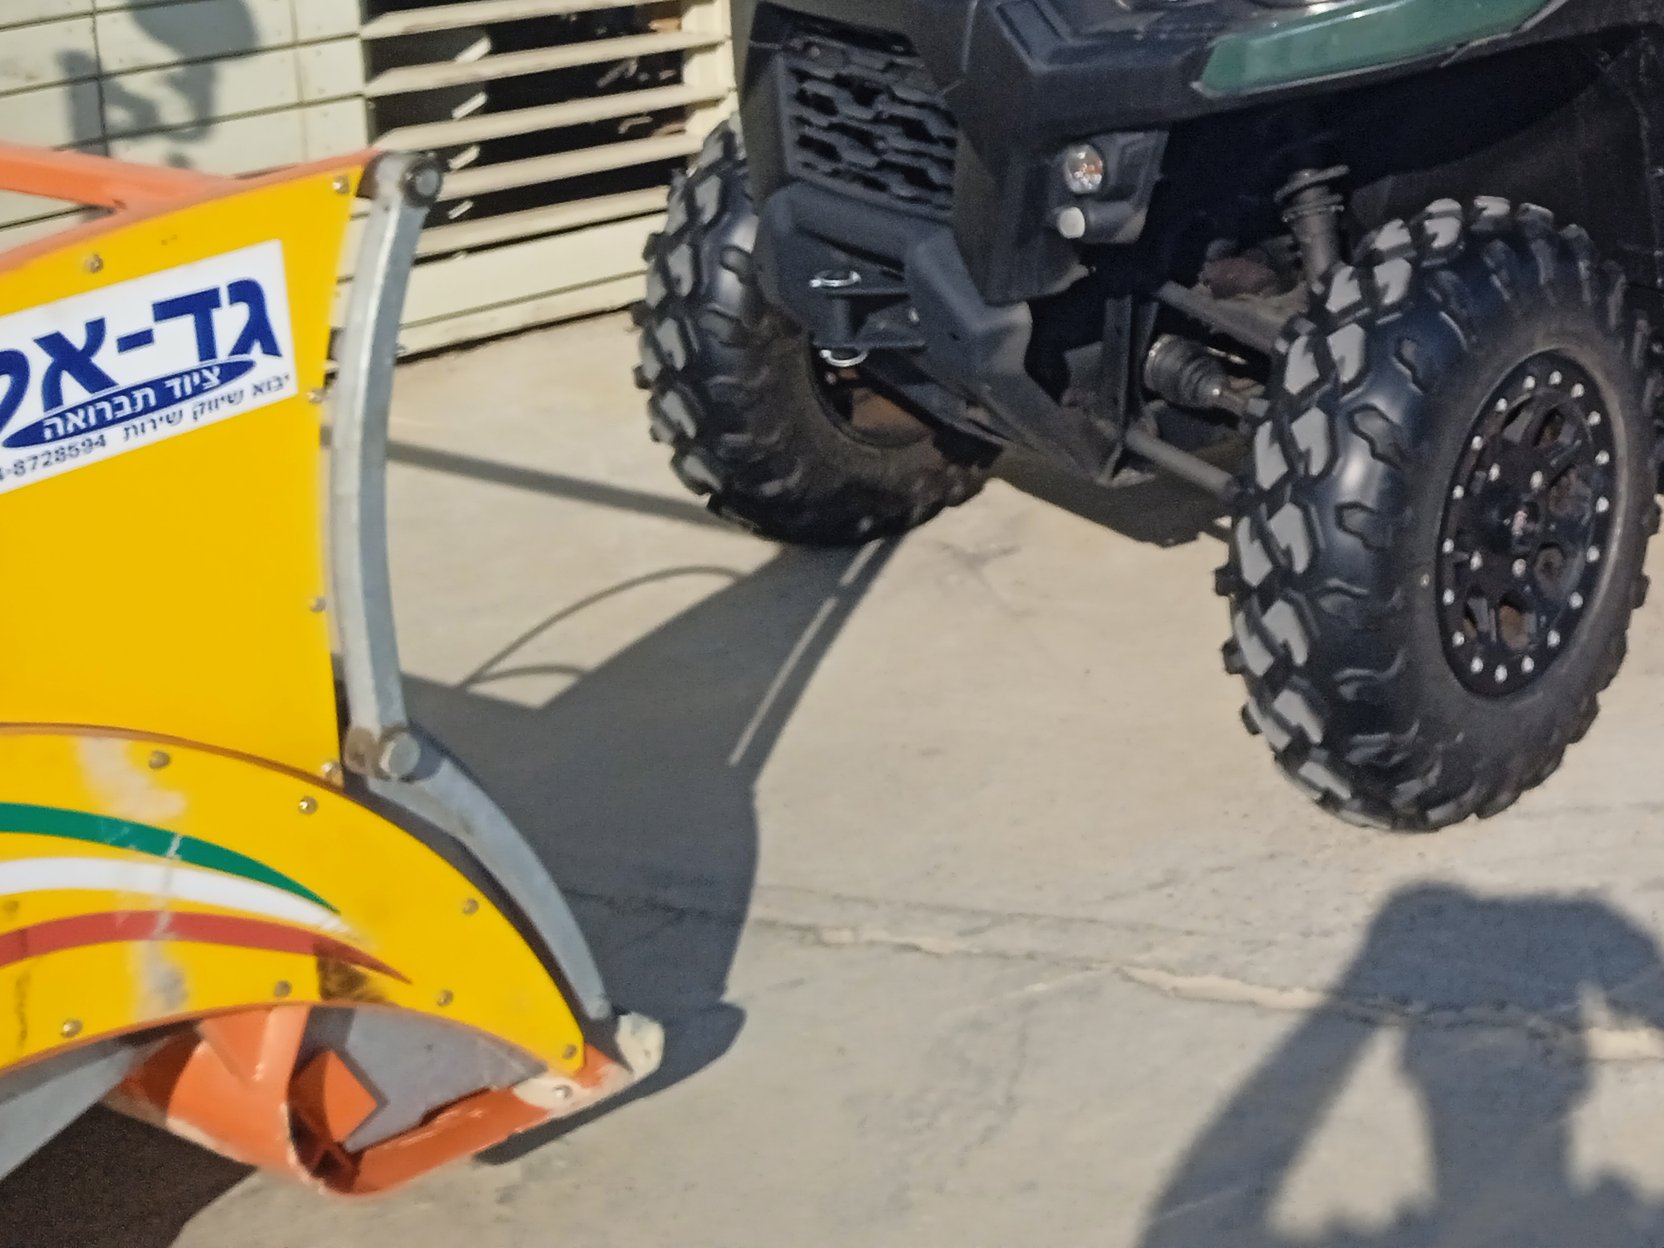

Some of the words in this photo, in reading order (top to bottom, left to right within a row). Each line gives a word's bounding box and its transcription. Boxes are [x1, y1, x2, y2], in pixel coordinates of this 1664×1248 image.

[164, 365, 222, 400] ציוד
[252, 373, 290, 398] יבוא
[42, 386, 158, 441] תברואה
[192, 389, 244, 422] שיווק
[122, 408, 184, 442] שירות
